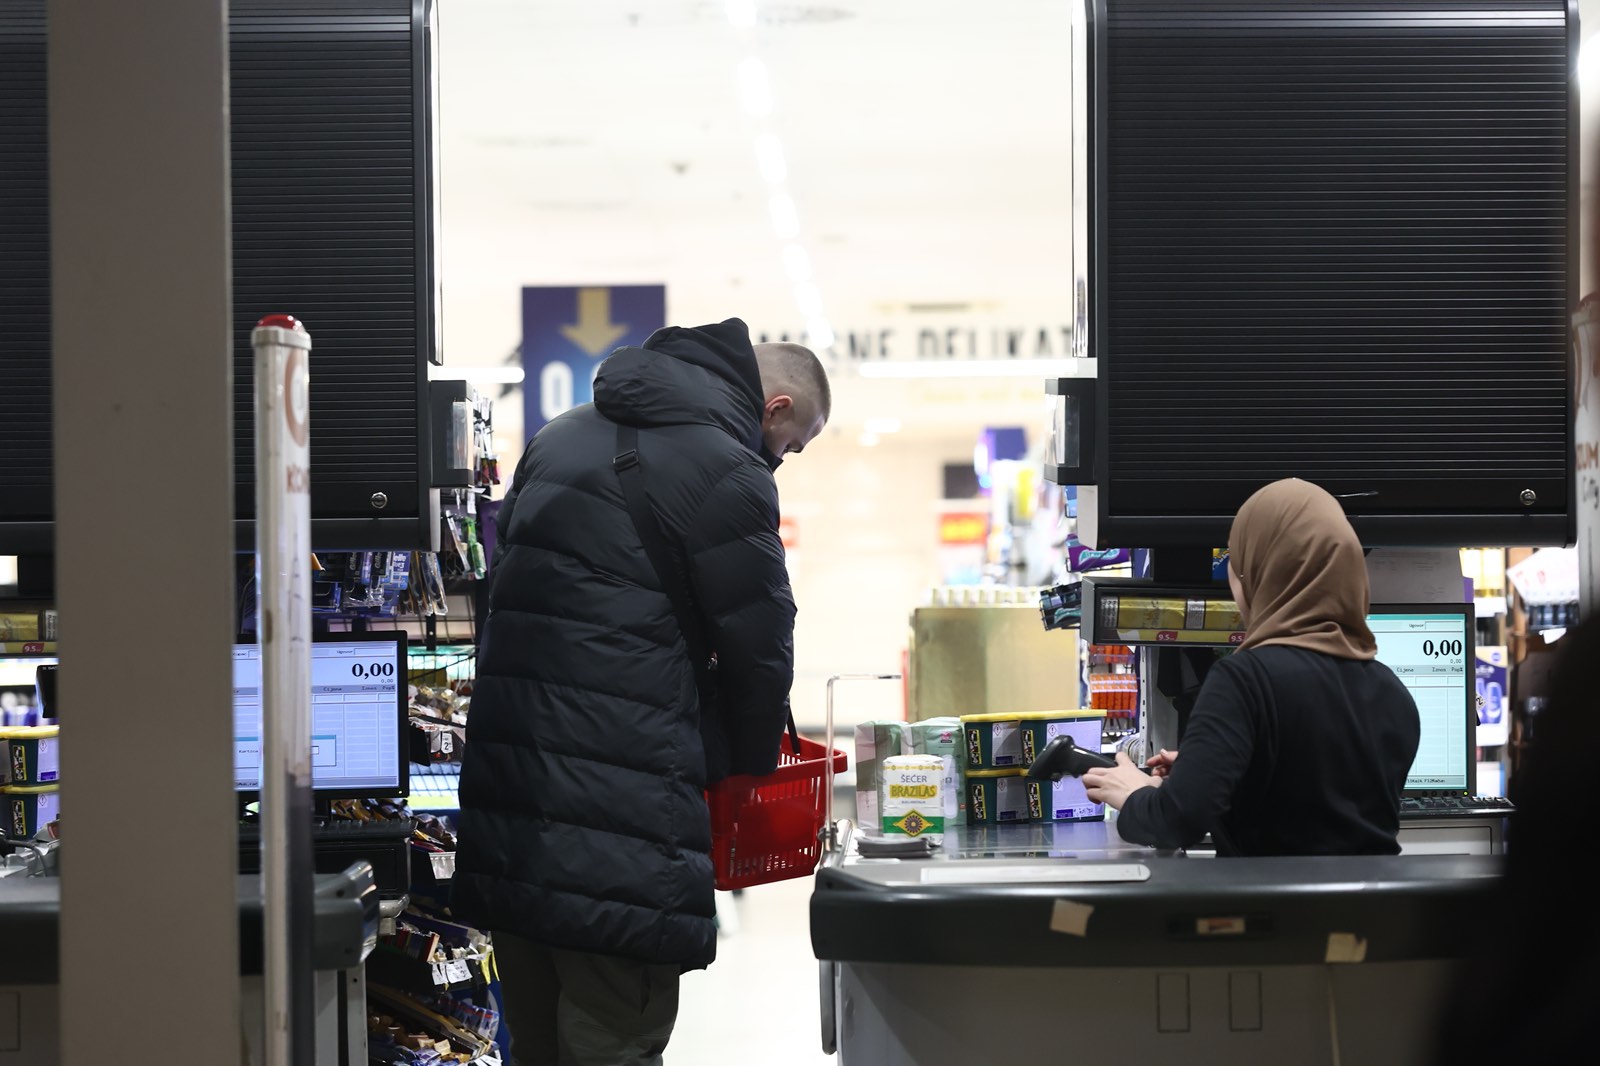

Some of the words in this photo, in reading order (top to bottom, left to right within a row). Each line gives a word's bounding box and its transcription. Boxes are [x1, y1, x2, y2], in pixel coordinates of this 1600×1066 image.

[1423, 639, 1463, 659] 0,00
[351, 662, 394, 680] 0,00
[900, 774, 928, 783] ŠEĆER
[890, 785, 936, 797] BRAZILAS
